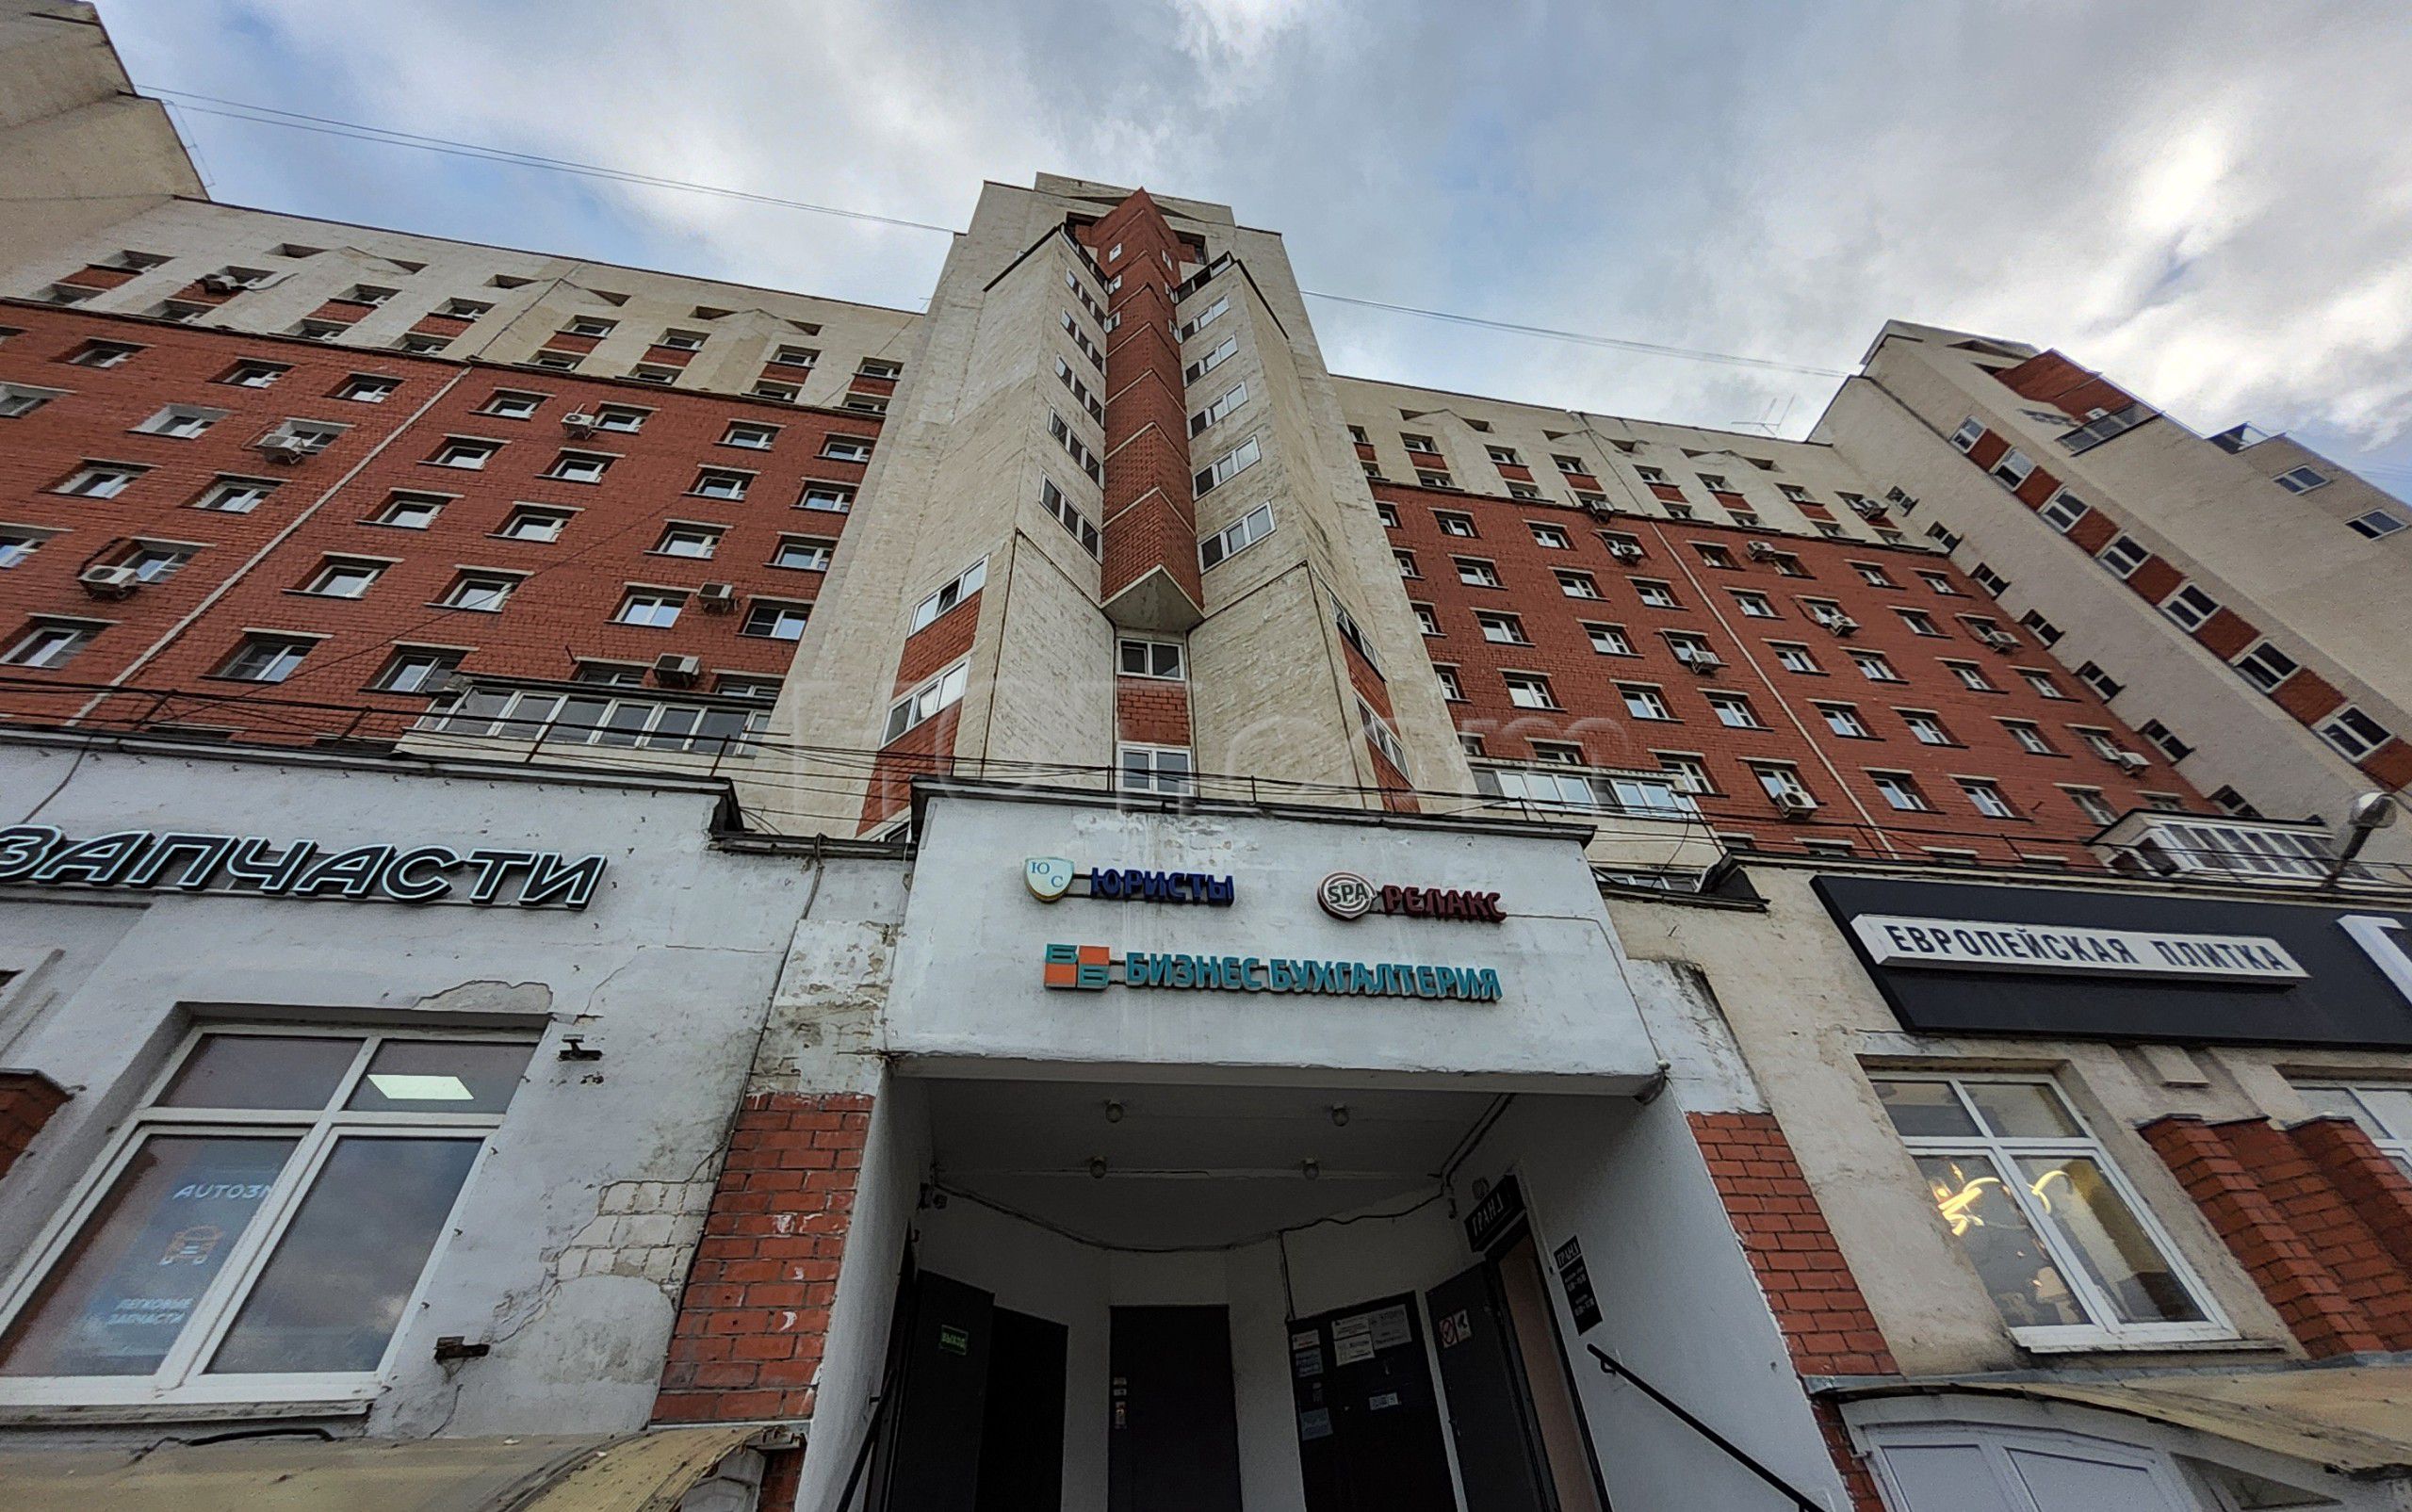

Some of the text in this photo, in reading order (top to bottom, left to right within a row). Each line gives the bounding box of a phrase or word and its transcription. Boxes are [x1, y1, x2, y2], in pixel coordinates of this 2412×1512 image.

[0, 824, 608, 910] ЗАПЧАСТИ
[1091, 867, 1235, 907] ЮРИСТЫ
[1327, 883, 1368, 904] SPA
[1381, 884, 1507, 923] РЕЛАКС
[1883, 924, 2293, 971] ЕВРОПЕЙСКАЯ ПЛИТКА
[1126, 951, 1504, 1002] БИЗНЕС БУХГАЛТЕРИЯ
